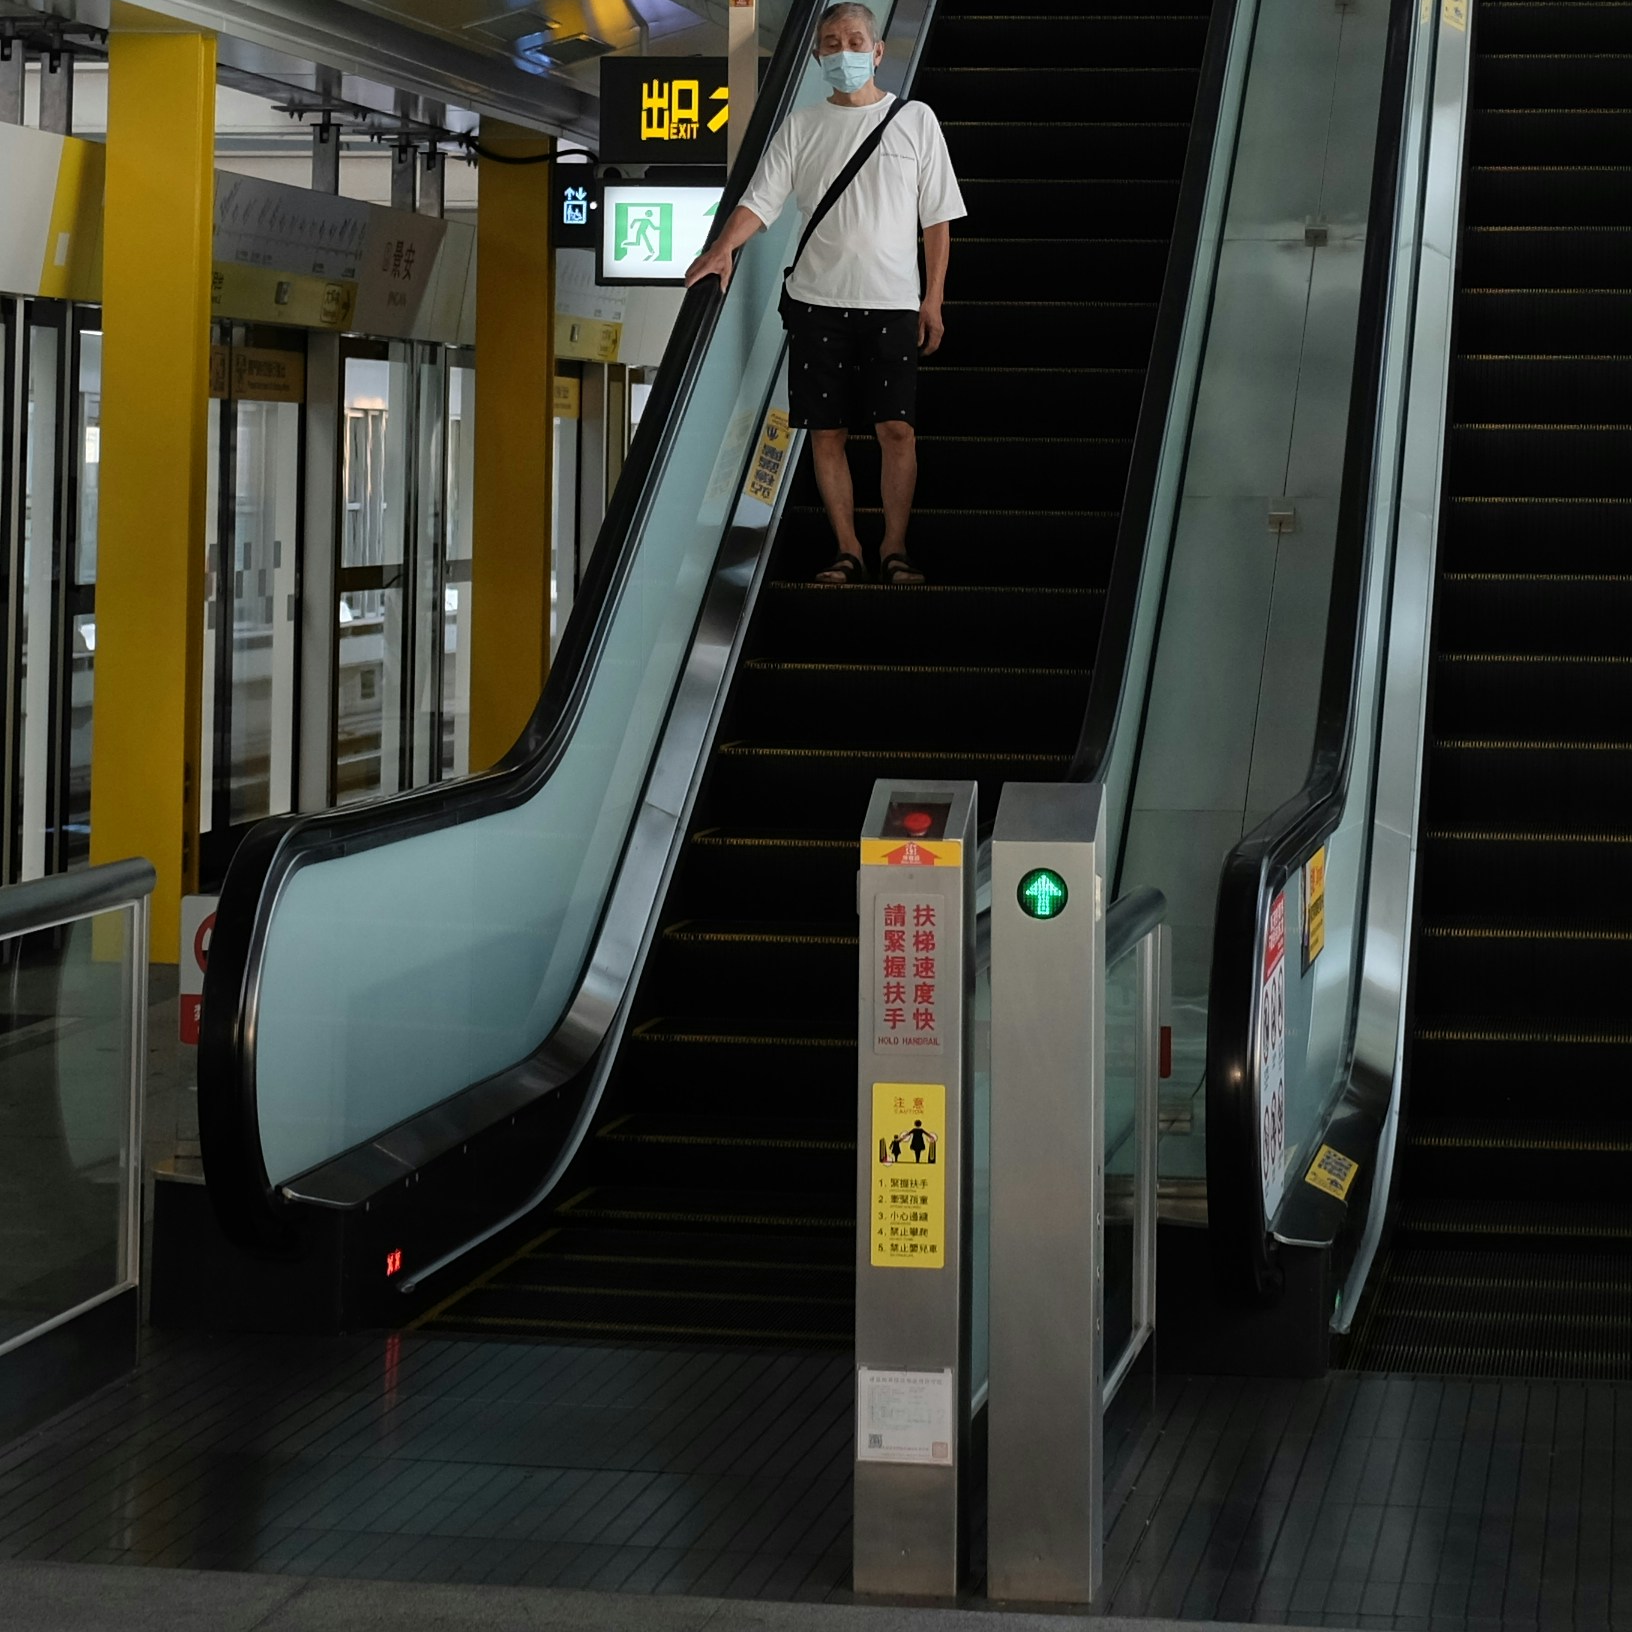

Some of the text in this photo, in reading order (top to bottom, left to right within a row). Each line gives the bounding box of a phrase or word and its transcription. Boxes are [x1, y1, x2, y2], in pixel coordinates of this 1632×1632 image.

[641, 79, 699, 140] 出口
[670, 122, 699, 140] EXIT
[883, 903, 906, 1030] 請緊握扶手
[912, 904, 936, 1031] 扶梯速度快
[878, 1037, 940, 1047] HOLD HANDRAIL
